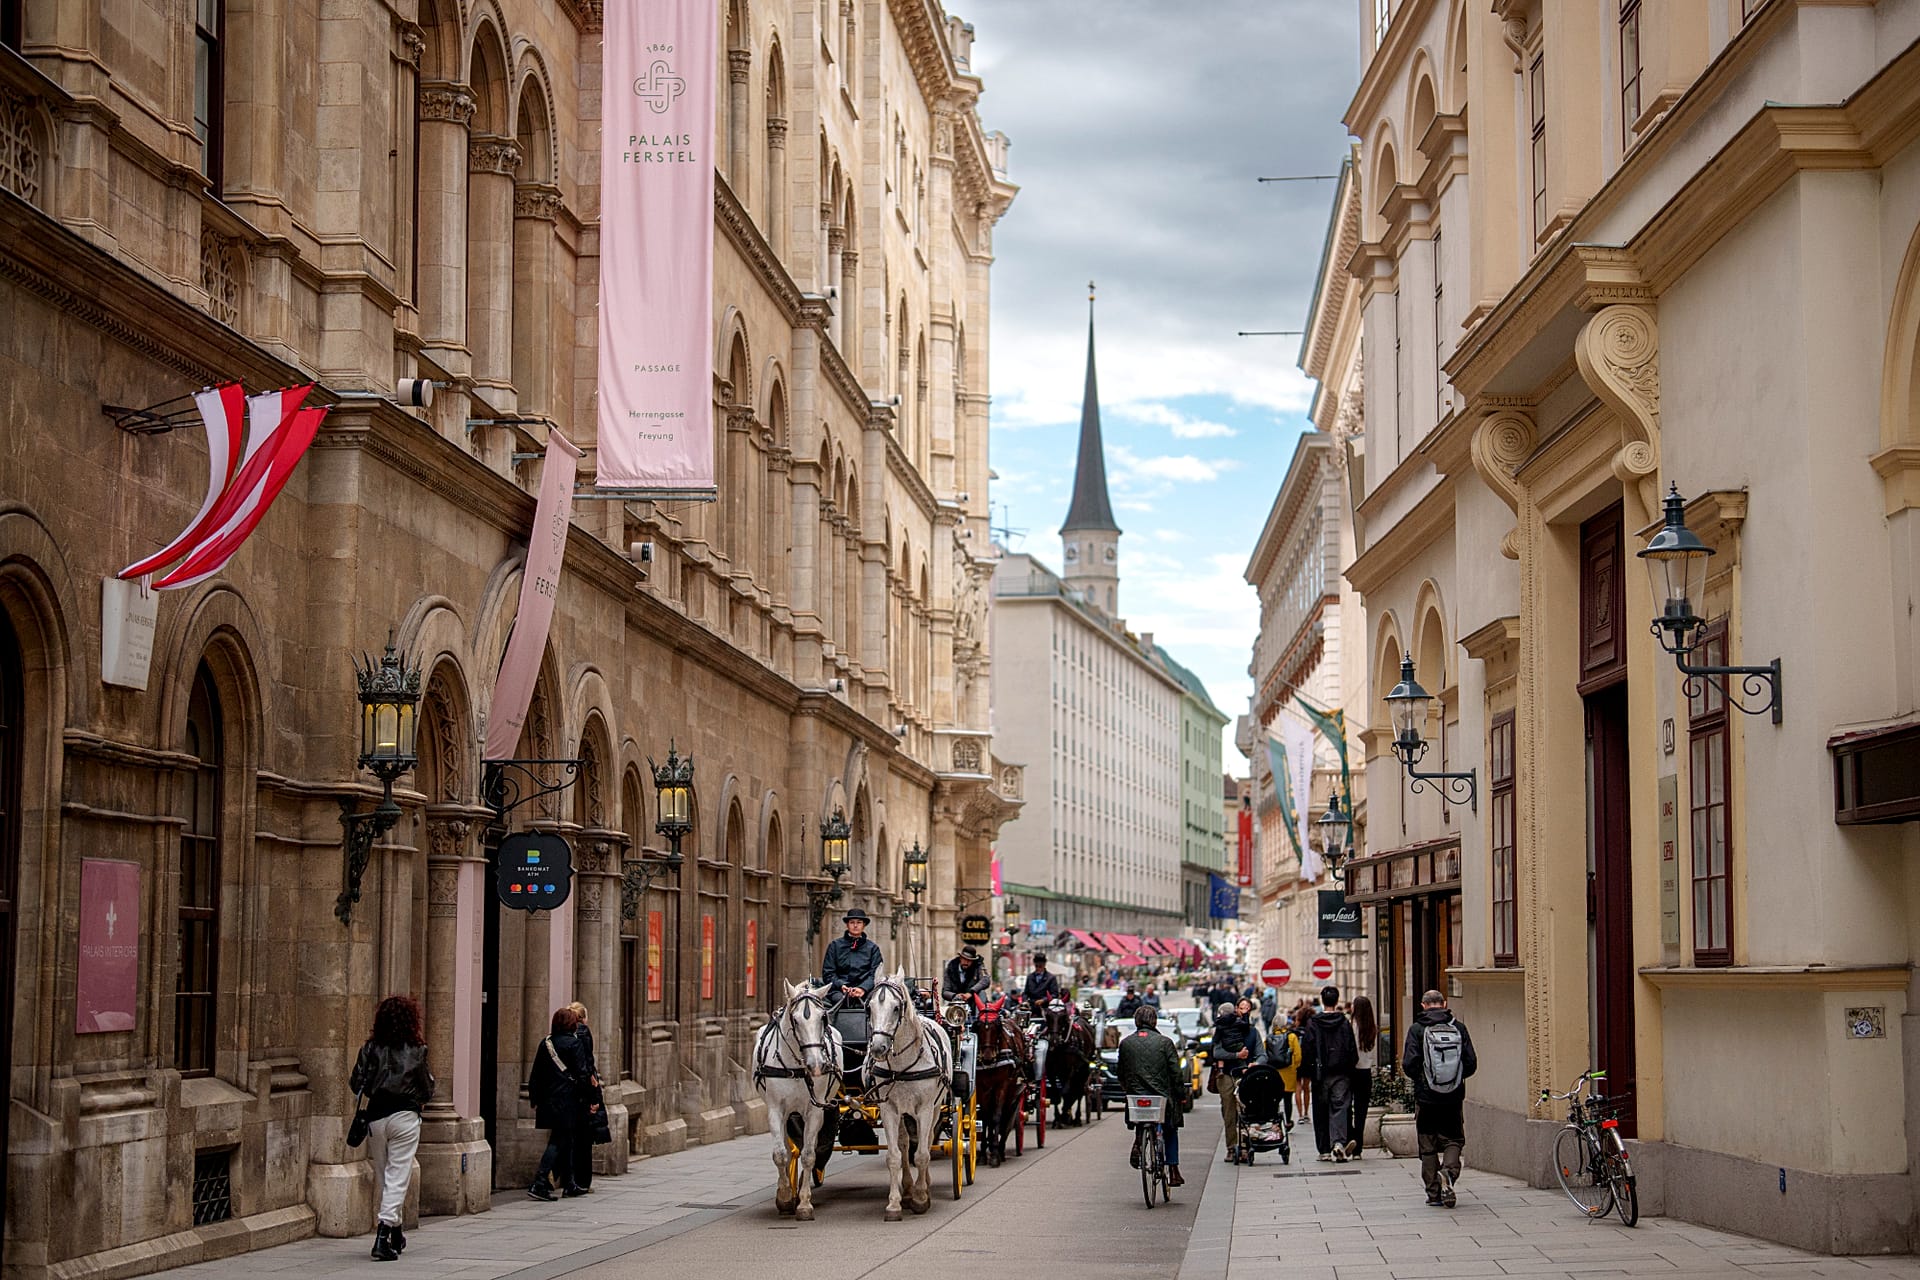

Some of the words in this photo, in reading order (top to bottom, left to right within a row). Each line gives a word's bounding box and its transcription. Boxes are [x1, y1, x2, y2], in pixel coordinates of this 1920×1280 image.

[646, 43, 674, 54] 1860
[629, 134, 691, 147] PALAIS
[623, 151, 697, 164] FERSTEL
[634, 364, 681, 373] PASSAGE
[628, 410, 685, 420] Herrengasse
[638, 431, 674, 441] Freyung
[82, 944, 104, 958] PALAIS
[104, 944, 137, 958] INTERIORS
